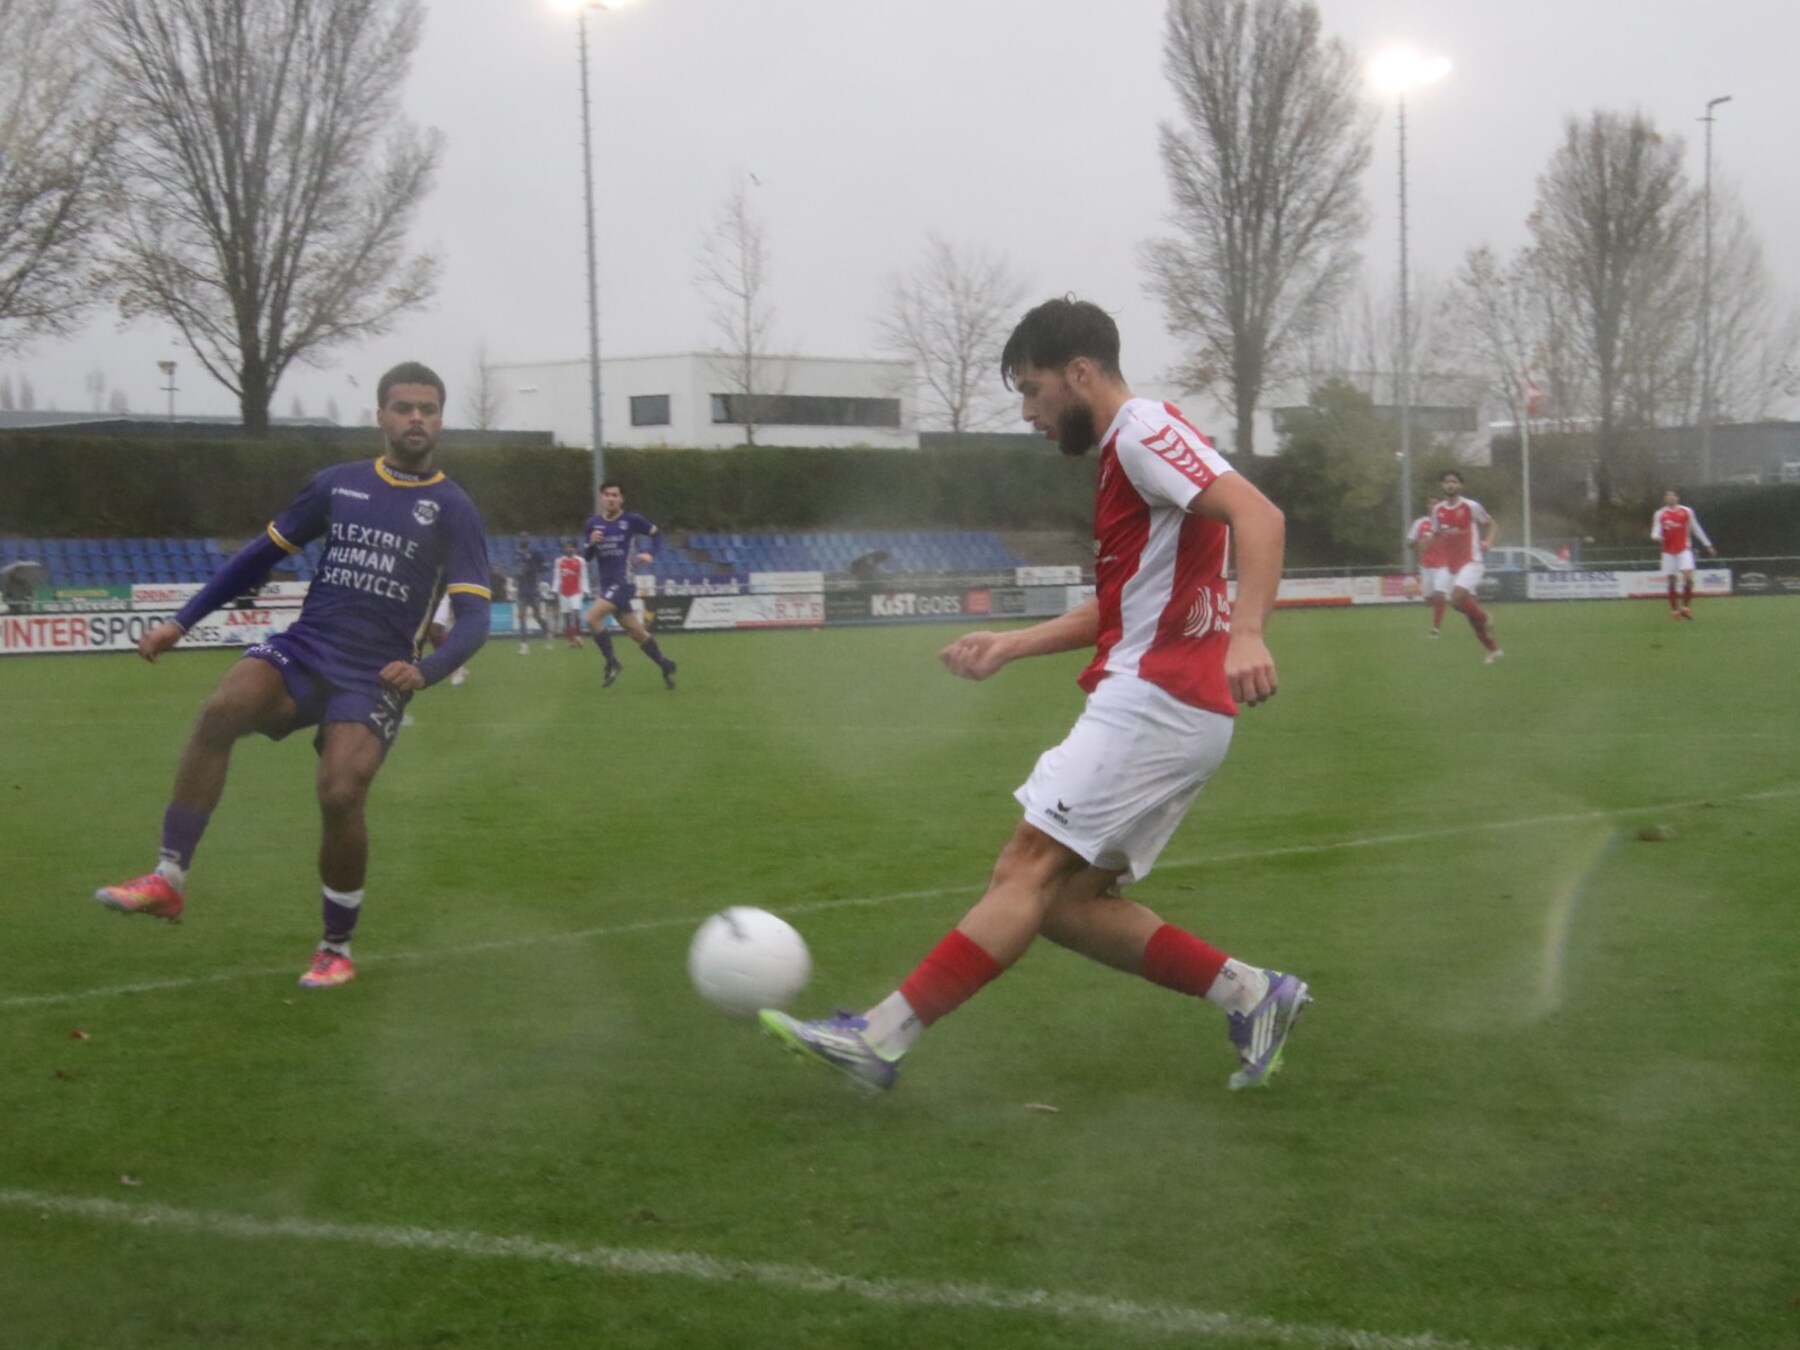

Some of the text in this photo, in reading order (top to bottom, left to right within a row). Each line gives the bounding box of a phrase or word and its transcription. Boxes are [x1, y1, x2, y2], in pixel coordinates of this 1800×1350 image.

[331, 522, 419, 560] FLEXIBLE
[327, 546, 396, 574] HUMAN
[321, 565, 411, 602] SERVICES
[3, 616, 176, 647] INTERSPO
